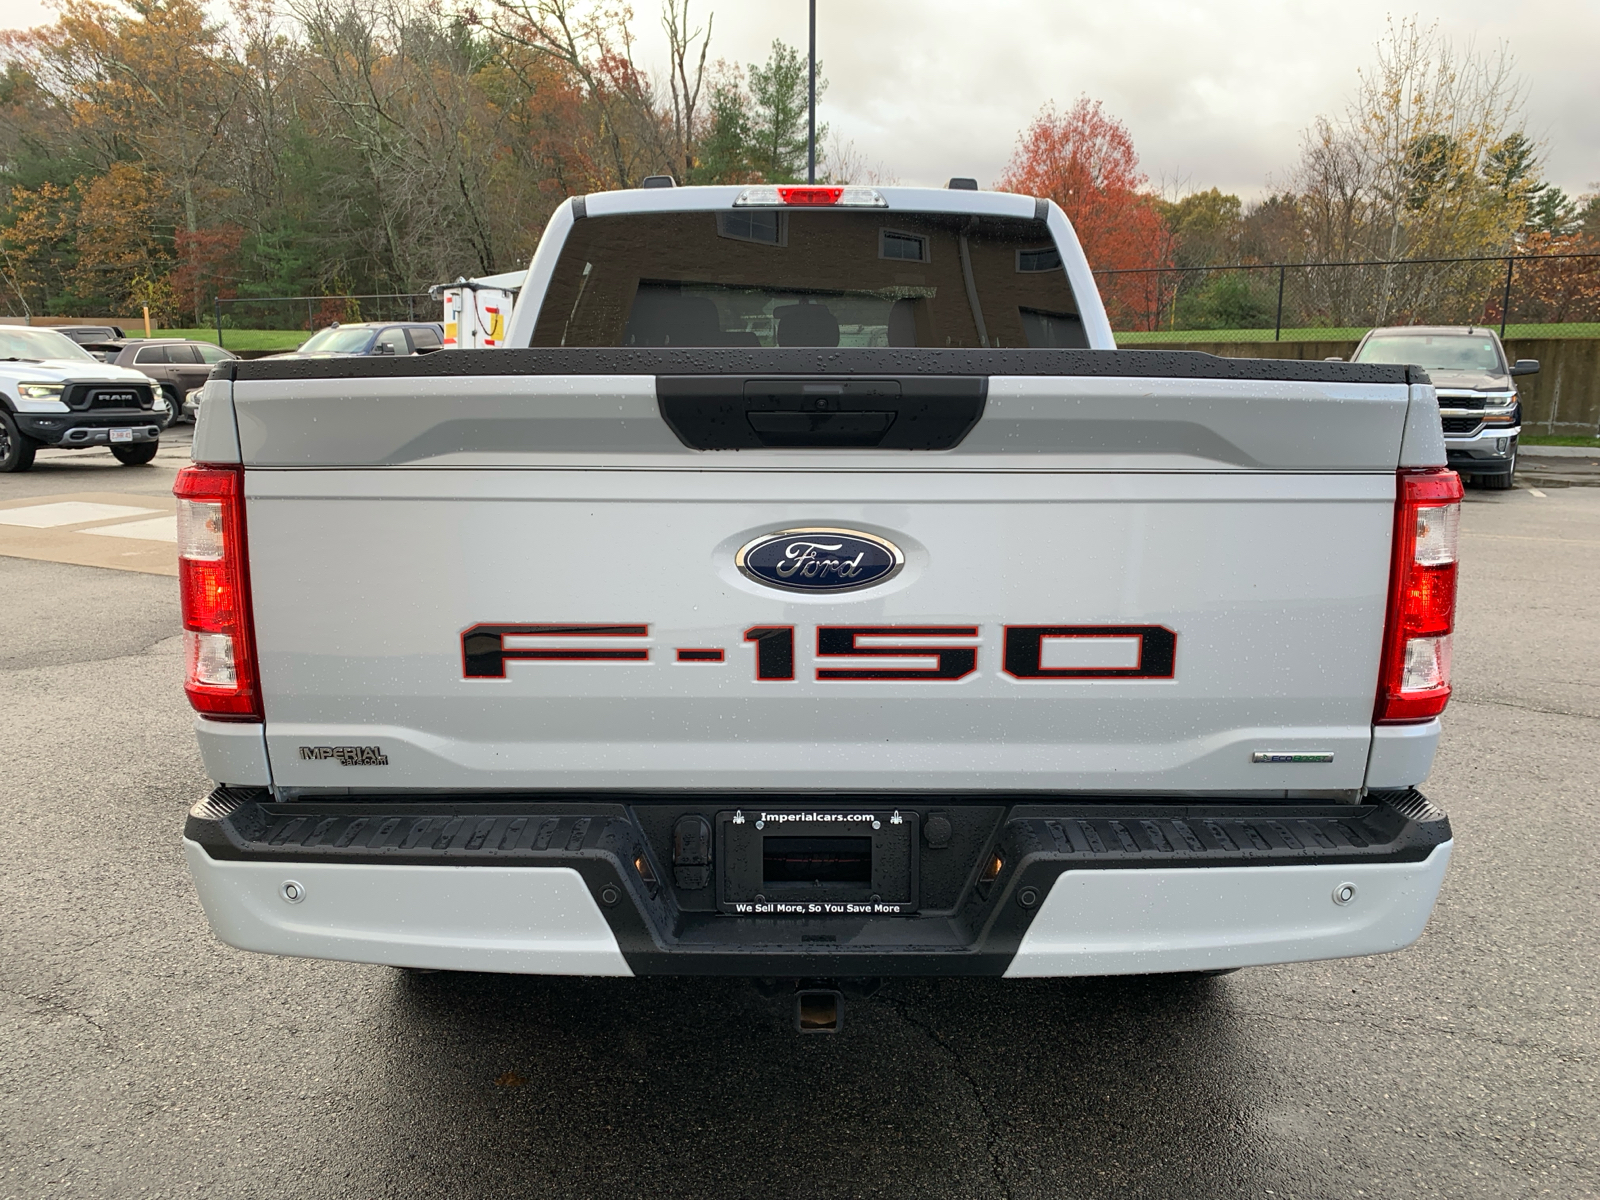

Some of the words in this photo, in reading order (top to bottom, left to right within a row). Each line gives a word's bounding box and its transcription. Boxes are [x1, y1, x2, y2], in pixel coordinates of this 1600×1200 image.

[776, 541, 864, 578] Ford
[460, 622, 1178, 682] F-150
[760, 812, 875, 823] Imperialcars.com
[736, 904, 753, 913] We
[755, 904, 774, 913] Sell
[777, 904, 805, 914] More,
[808, 904, 822, 913] So
[824, 904, 844, 913] You
[846, 904, 872, 913] Save
[874, 904, 900, 913] More
